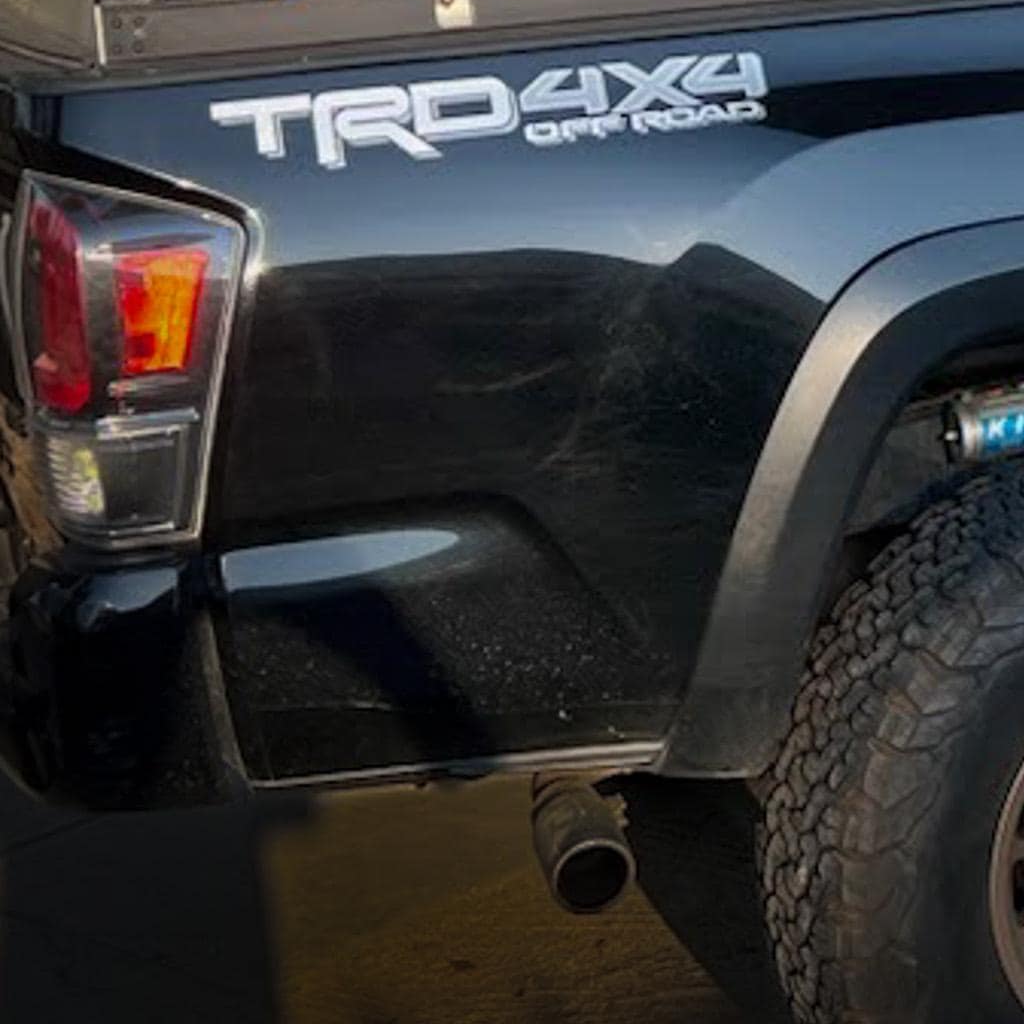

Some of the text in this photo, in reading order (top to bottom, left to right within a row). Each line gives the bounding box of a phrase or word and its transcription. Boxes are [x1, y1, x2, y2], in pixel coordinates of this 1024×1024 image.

[209, 76, 518, 170] TRD
[523, 99, 768, 146] OFF ROAD
